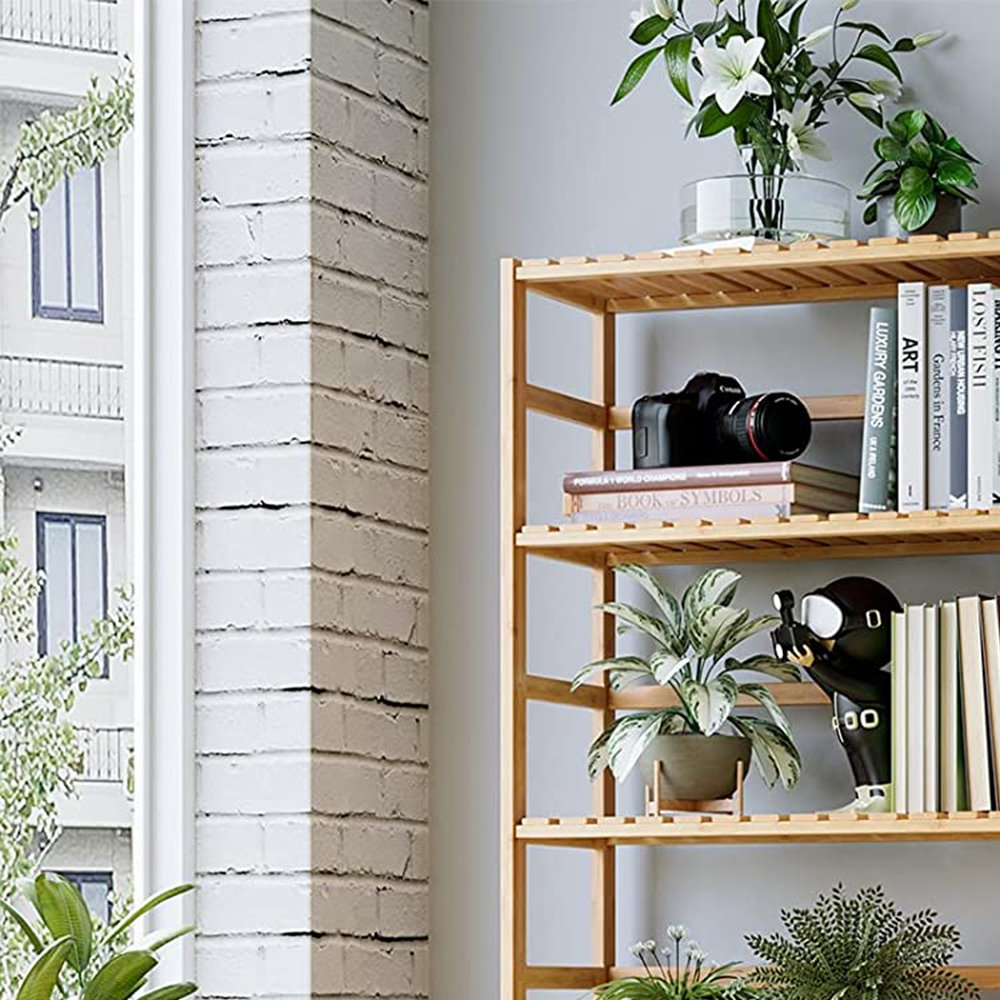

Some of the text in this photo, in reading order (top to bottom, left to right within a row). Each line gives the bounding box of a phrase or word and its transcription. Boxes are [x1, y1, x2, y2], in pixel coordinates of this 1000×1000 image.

[870, 321, 889, 428] LUXURY GARDENS
[902, 336, 919, 373] ART
[972, 290, 987, 388] LOST FISH
[932, 353, 945, 451] Gardens in France
[617, 493, 662, 511] BOOK
[679, 488, 762, 507] SYMBOLS
